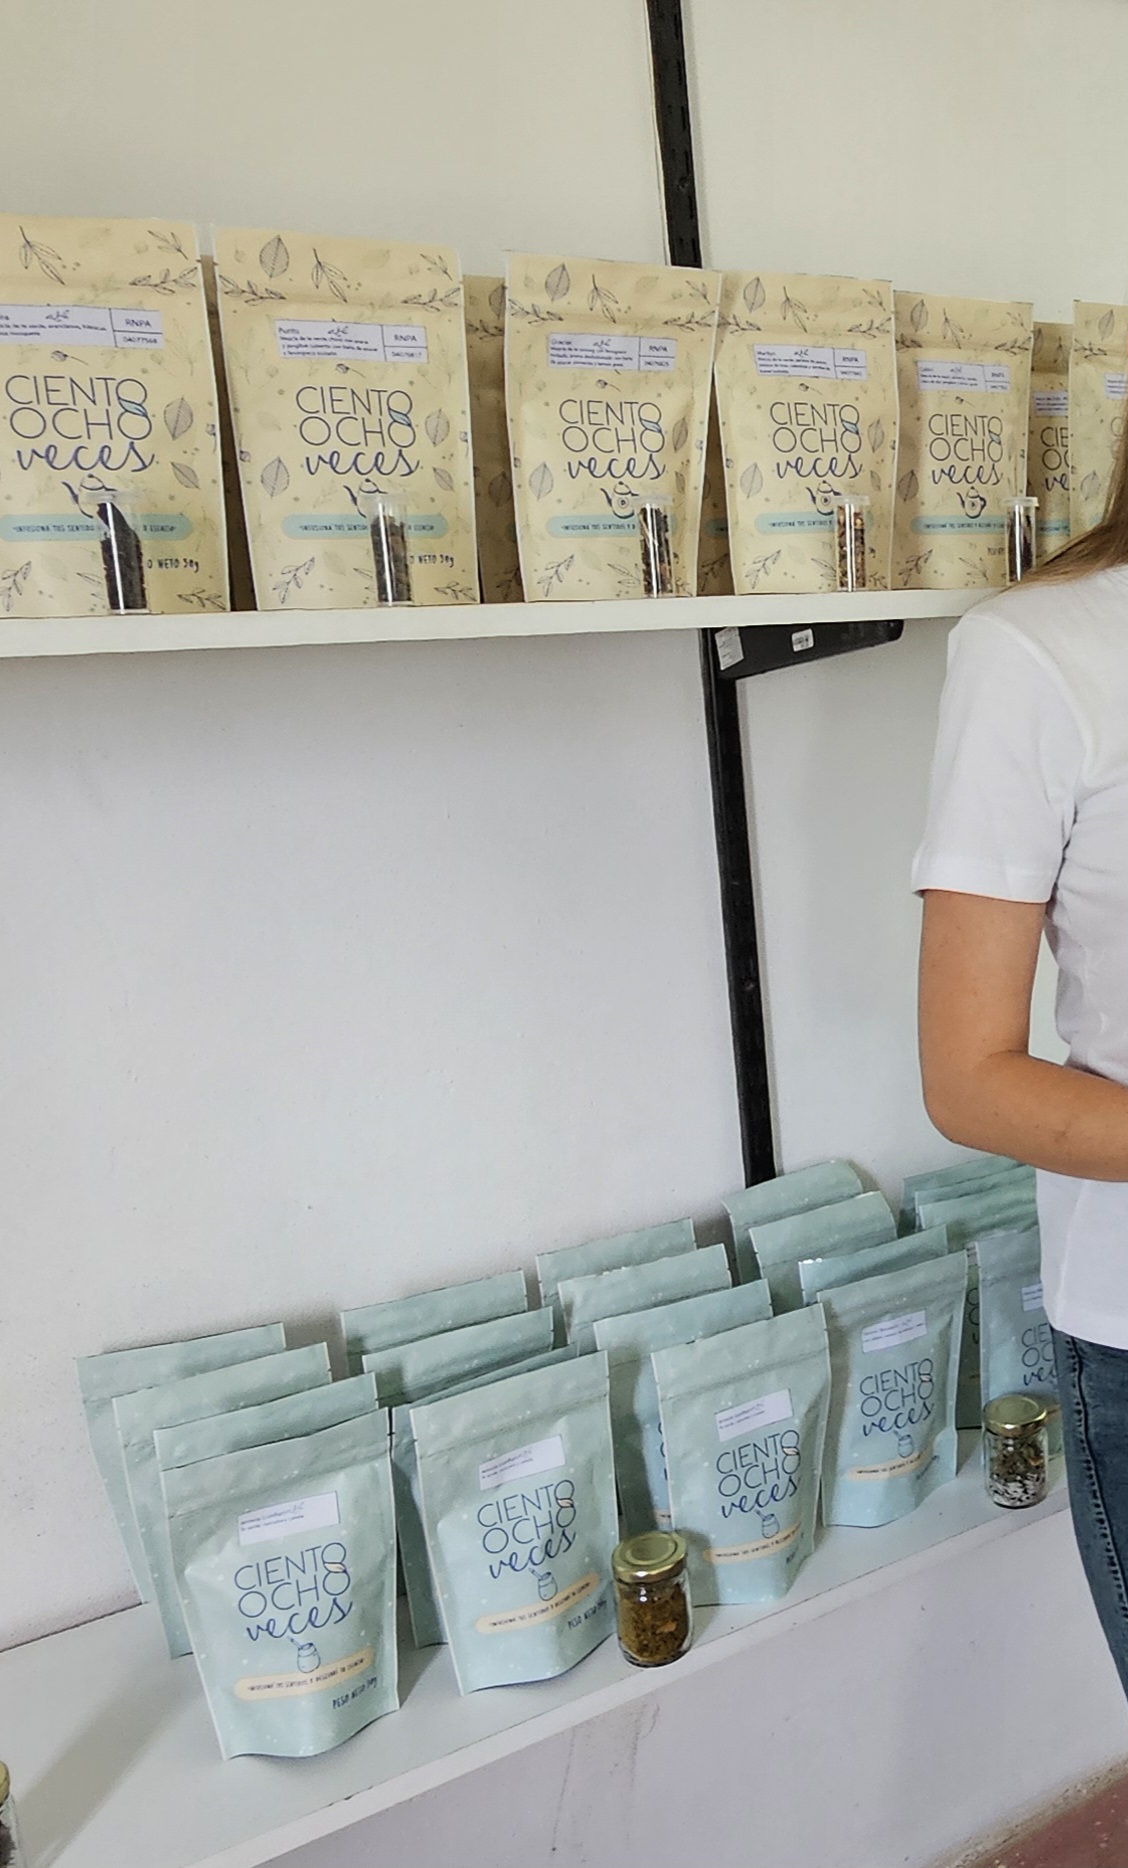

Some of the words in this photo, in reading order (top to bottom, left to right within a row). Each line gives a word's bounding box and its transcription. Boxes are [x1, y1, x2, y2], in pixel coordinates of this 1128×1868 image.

[5, 374, 148, 407] CIENTO
[296, 386, 413, 416] CIENTO
[10, 406, 152, 441] OCHO
[558, 398, 662, 426] CIENTO
[769, 401, 860, 427] CIENTO
[928, 413, 1003, 437] CIENTO
[299, 416, 416, 449] OCHO
[562, 426, 666, 454] OCHO
[772, 426, 862, 453] OCHO
[1040, 426, 1069, 448] CIE
[16, 441, 155, 473] veces
[305, 449, 420, 477] veces
[929, 437, 1003, 463] OCHO
[1042, 448, 1069, 471] OC
[567, 453, 667, 480] veces
[776, 453, 863, 480] veces
[931, 463, 1004, 486] veces
[1021, 1322, 1050, 1347] CIE
[1021, 1341, 1054, 1368] OC
[859, 1357, 934, 1398] CIENTO
[860, 1376, 934, 1417] OCHO
[861, 1402, 933, 1437] veces
[715, 1429, 800, 1475] CIENTO
[718, 1450, 801, 1497] OCHO
[477, 1479, 575, 1529] CIENTO
[720, 1479, 799, 1519] veces
[482, 1504, 577, 1555] OCHO
[234, 1542, 347, 1592] CIENTO
[488, 1529, 577, 1580] veces
[237, 1569, 352, 1618] OCHO
[245, 1597, 354, 1643] veces
